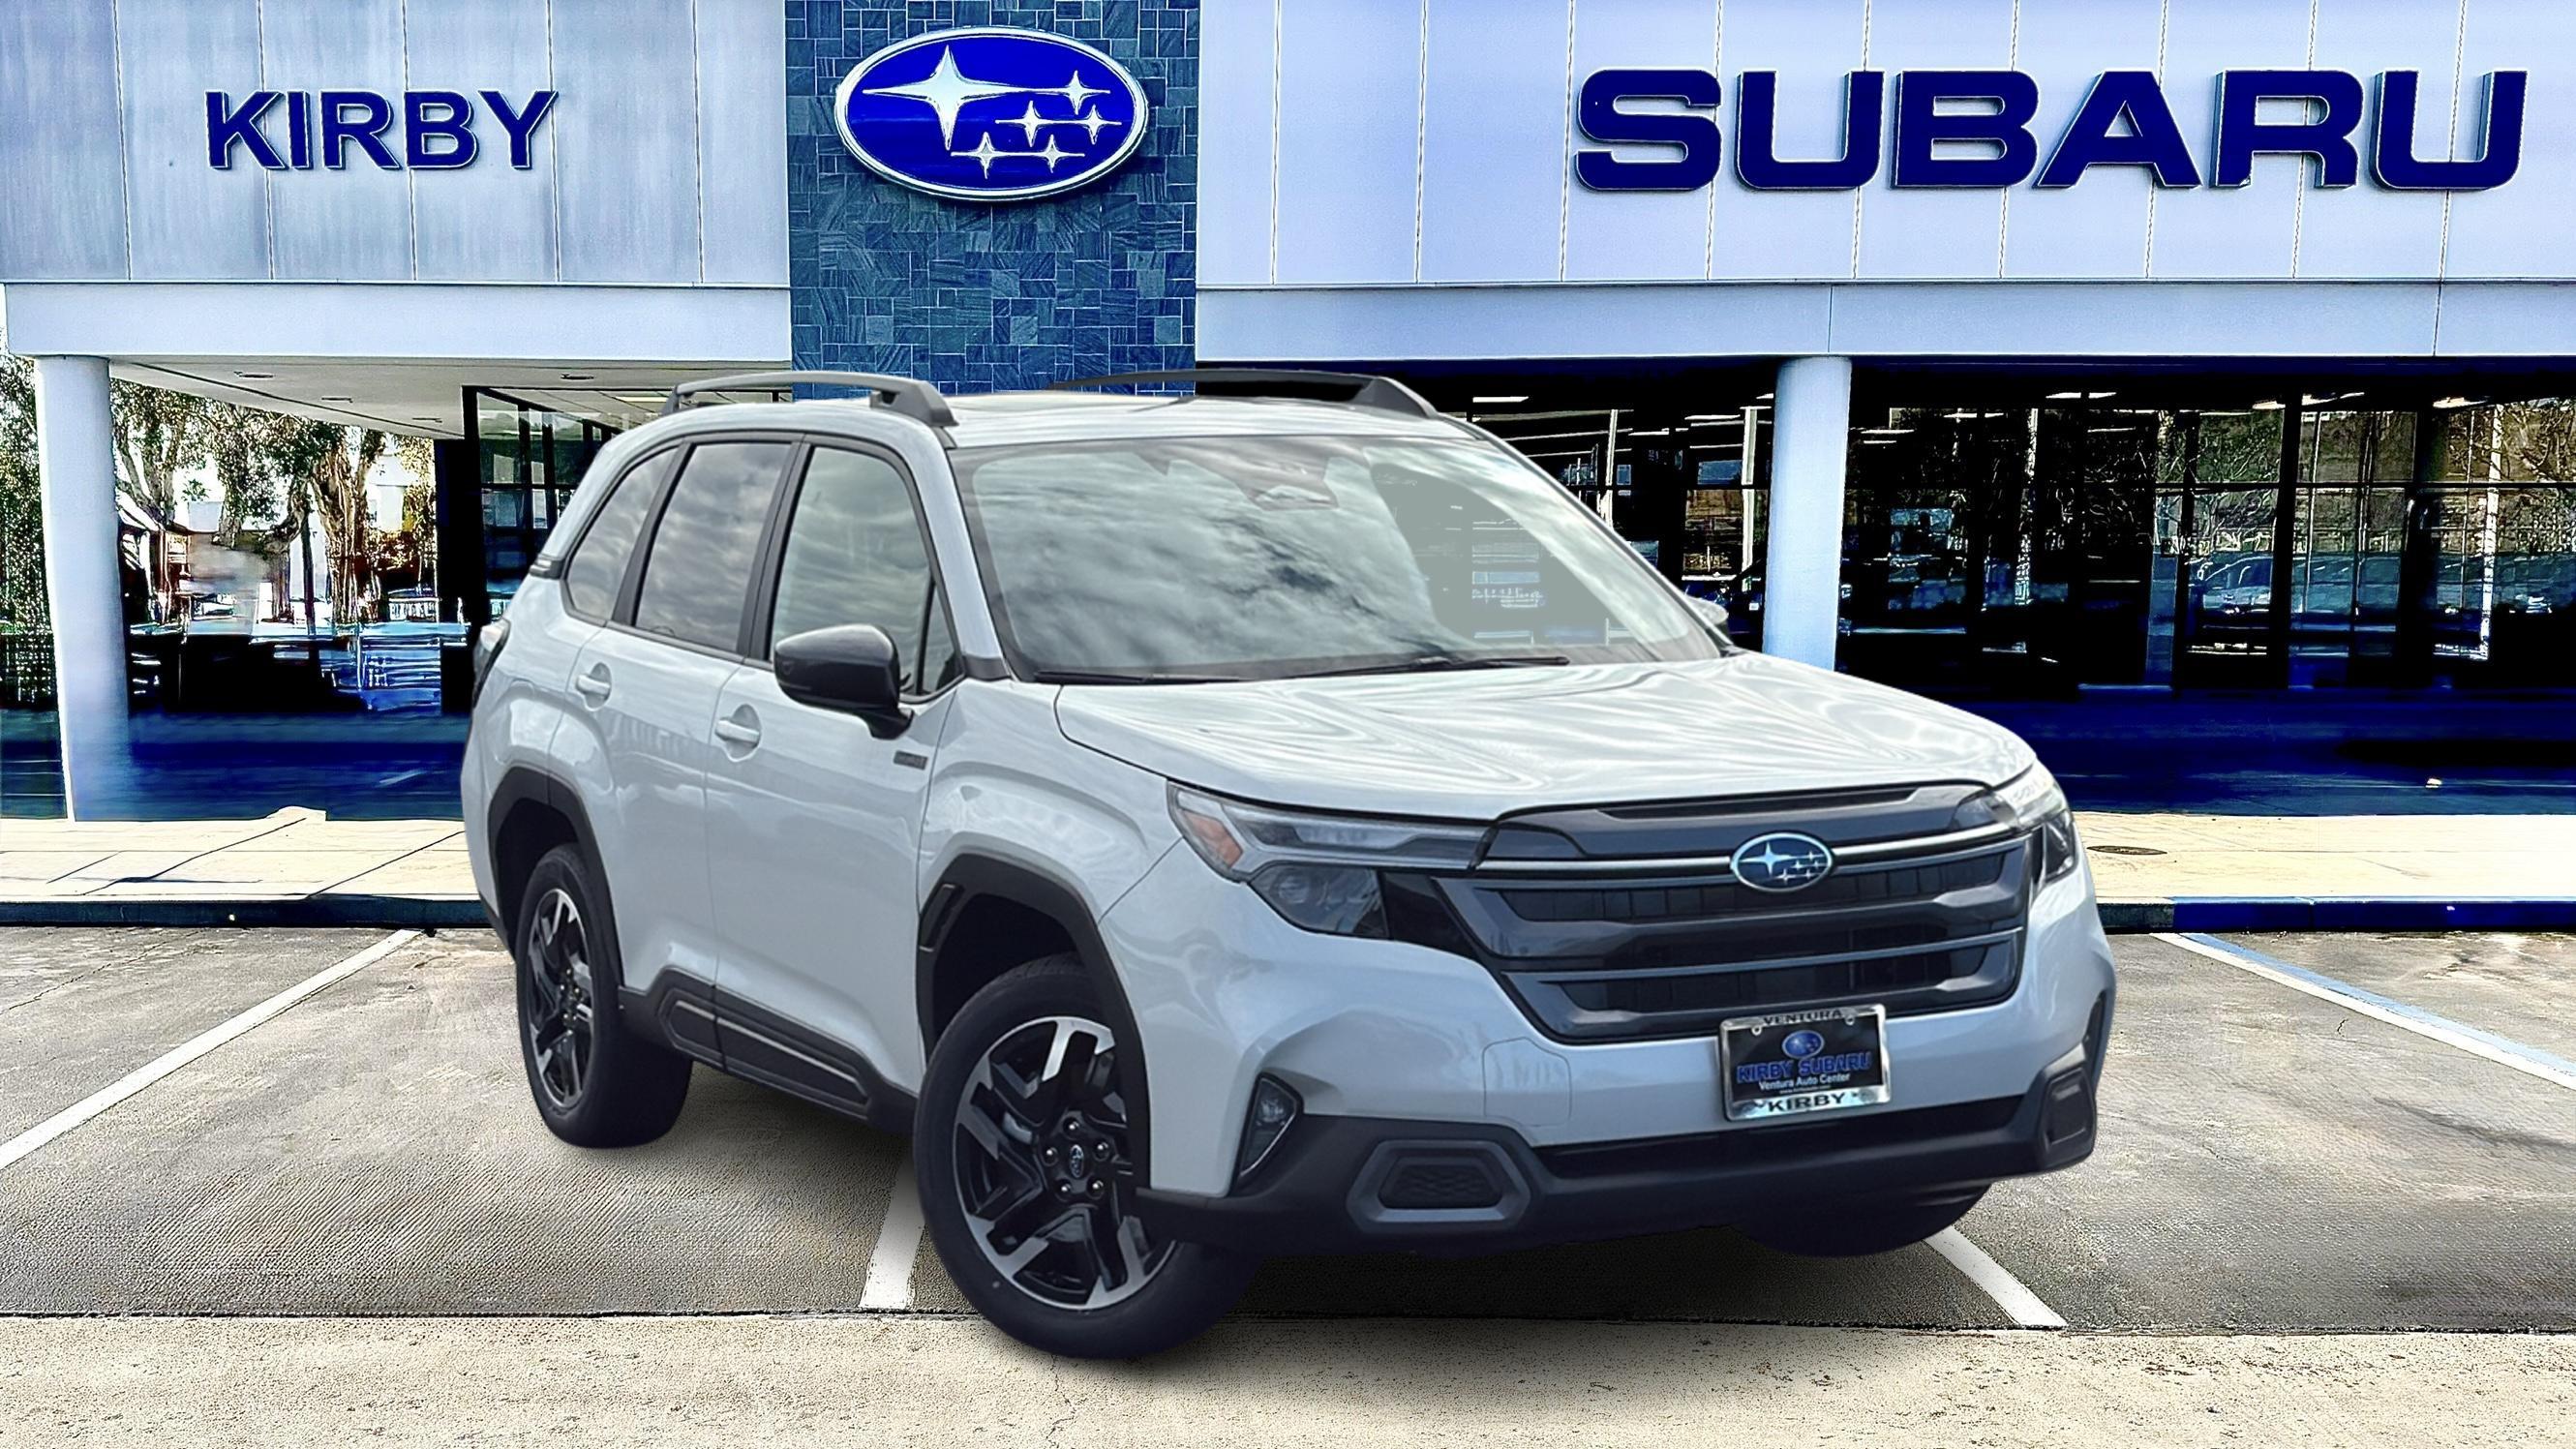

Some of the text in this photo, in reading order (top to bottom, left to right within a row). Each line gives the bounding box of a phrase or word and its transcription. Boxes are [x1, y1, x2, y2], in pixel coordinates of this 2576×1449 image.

[204, 89, 559, 170] KIRBY
[1575, 69, 2529, 191] SUBARU
[1763, 1009, 1843, 1026] VENTURA
[1737, 1052, 1872, 1083] KIRBY SUBARU
[1759, 1078, 1794, 1091] Ventura
[1797, 1075, 1818, 1087] Auto
[1819, 1072, 1851, 1084] Center
[1768, 1092, 1845, 1112] KIRBY
